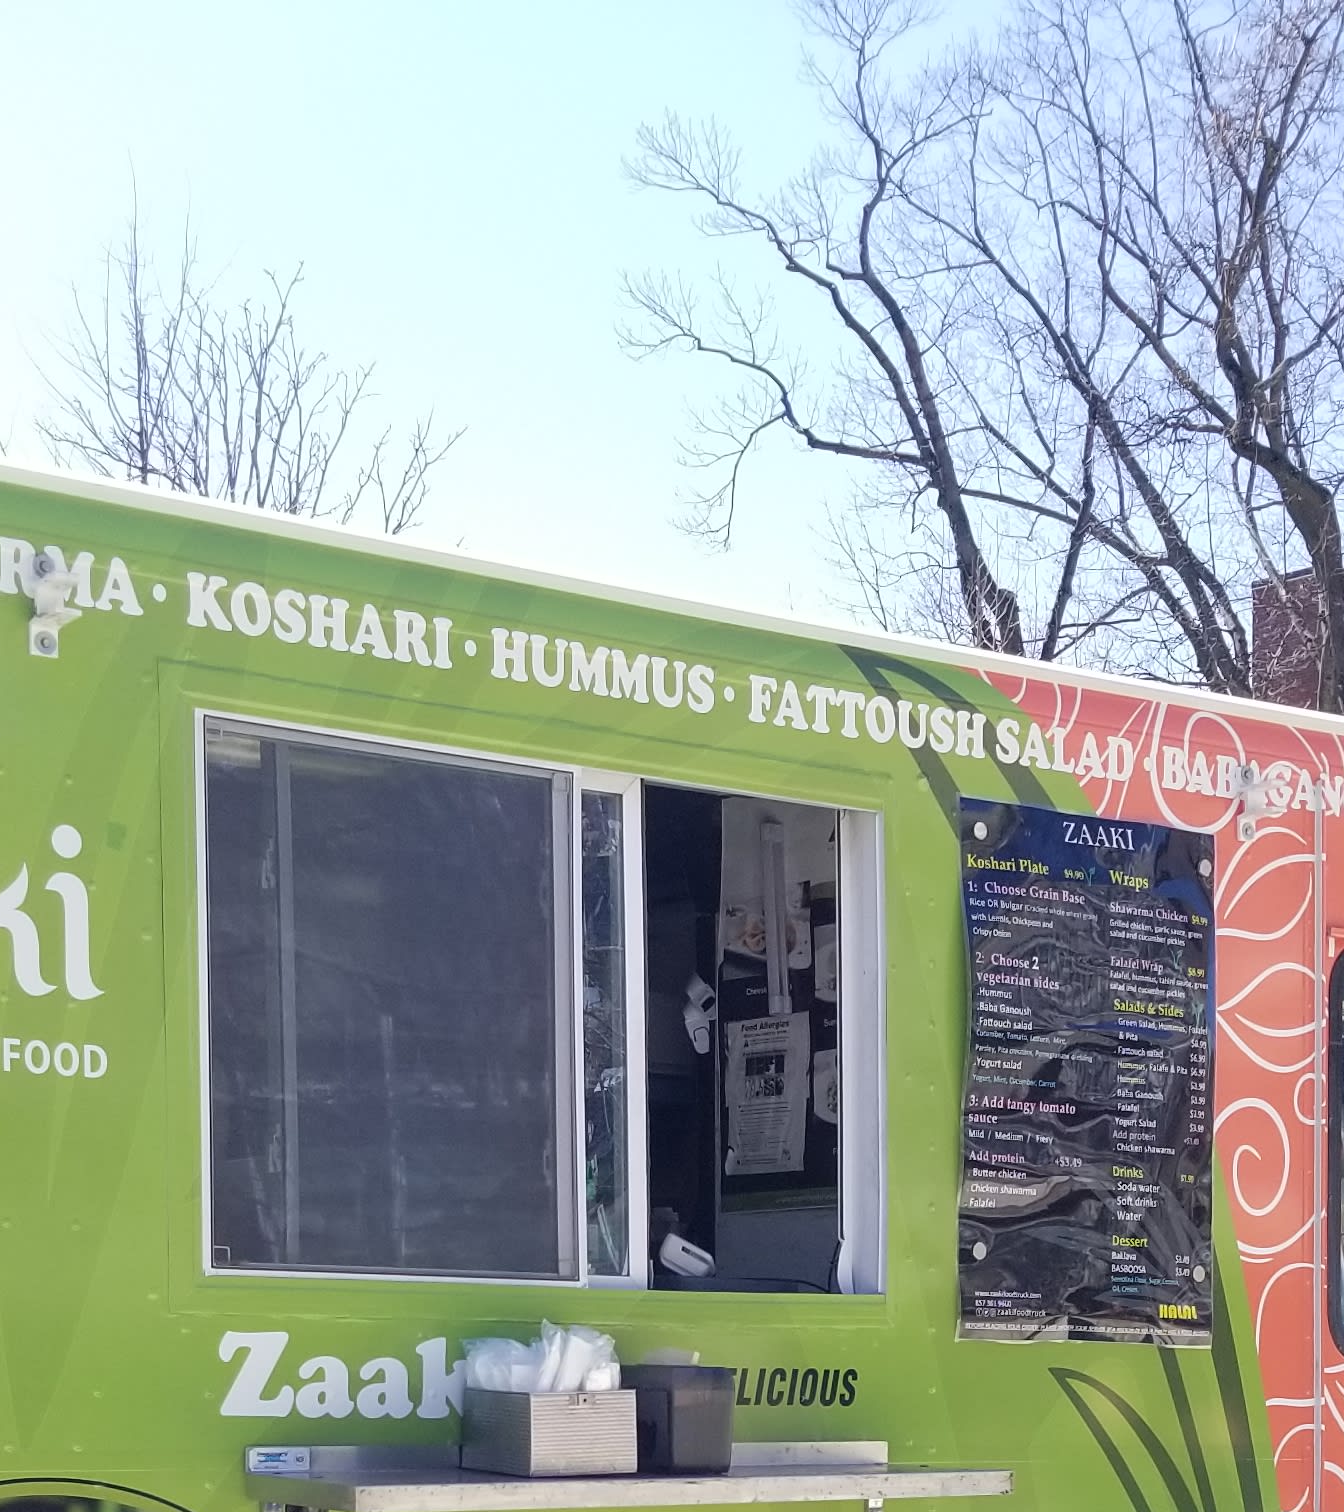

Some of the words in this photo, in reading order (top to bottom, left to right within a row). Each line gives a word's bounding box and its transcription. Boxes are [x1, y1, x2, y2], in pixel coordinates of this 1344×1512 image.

[185, 572, 454, 669] KOSHARI
[490, 627, 716, 714] HUMMUS
[748, 674, 987, 759] FATTOUSH
[994, 717, 1136, 783] SALAD
[1062, 821, 1136, 851] ZAAKI
[967, 854, 1016, 872] Koshari
[1020, 859, 1050, 875] Plate
[1109, 869, 1149, 892] Wraps
[967, 881, 978, 893] 1:
[984, 881, 1027, 897] Choose
[1029, 886, 1059, 901] Grain
[1062, 890, 1086, 905] Base
[969, 898, 985, 907] Rice
[1000, 901, 1023, 912] Bulgar
[971, 912, 987, 921] with
[1109, 901, 1154, 918] Shawarma
[1156, 908, 1188, 923] Chicken
[1109, 919, 1129, 929] Grilled
[972, 926, 992, 938] Crispy
[991, 953, 1030, 969] Choose
[1032, 956, 1040, 970] 2
[1110, 955, 1139, 970] Falafel
[1141, 959, 1163, 975] Wrap
[976, 971, 1031, 987] vegetarian
[1033, 977, 1060, 990] sides
[999, 1003, 1032, 1016] Ganoush
[1114, 999, 1145, 1014] Salads
[1148, 1004, 1156, 1014] &
[1158, 1004, 1184, 1018] Sides
[1013, 1020, 1033, 1031] salad
[1118, 1018, 1137, 1027] Green
[1126, 1032, 1138, 1041] Pita
[1, 1038, 109, 1080] FOOD
[1002, 1060, 1022, 1070] salad
[969, 1094, 978, 1106] 3:
[981, 1095, 1005, 1109] Add
[1007, 1098, 1037, 1115] tangy
[1039, 1100, 1076, 1115] tomato
[1117, 1103, 1140, 1113] Falafel
[968, 1112, 998, 1124] sauce
[1138, 1119, 1157, 1128] Salad
[968, 1129, 985, 1139] Mild
[994, 1131, 1024, 1142] Medium
[1113, 1129, 1128, 1139] Add
[1129, 1131, 1156, 1142] protein
[1116, 1143, 1143, 1153] Chicken
[969, 1150, 989, 1161] Add
[991, 1153, 1025, 1165] protein
[972, 1167, 997, 1178] Butter
[998, 1169, 1027, 1180] chicken
[1112, 1165, 1144, 1179] Drinks
[970, 1183, 999, 1194] Chicken
[999, 1185, 1037, 1196] shawarma
[1117, 1181, 1137, 1192] Soda
[1138, 1184, 1161, 1193] water
[969, 1197, 996, 1208] Falafel
[1116, 1196, 1134, 1206] Soft
[1134, 1197, 1157, 1208] drinks
[1116, 1210, 1143, 1221] Water
[1112, 1234, 1149, 1248] Dessert
[1111, 1264, 1147, 1274] BASBOOSA
[1159, 1303, 1198, 1320] HALAL
[219, 1330, 467, 1419] Zaak
[726, 1367, 858, 1407] LICIOUS
